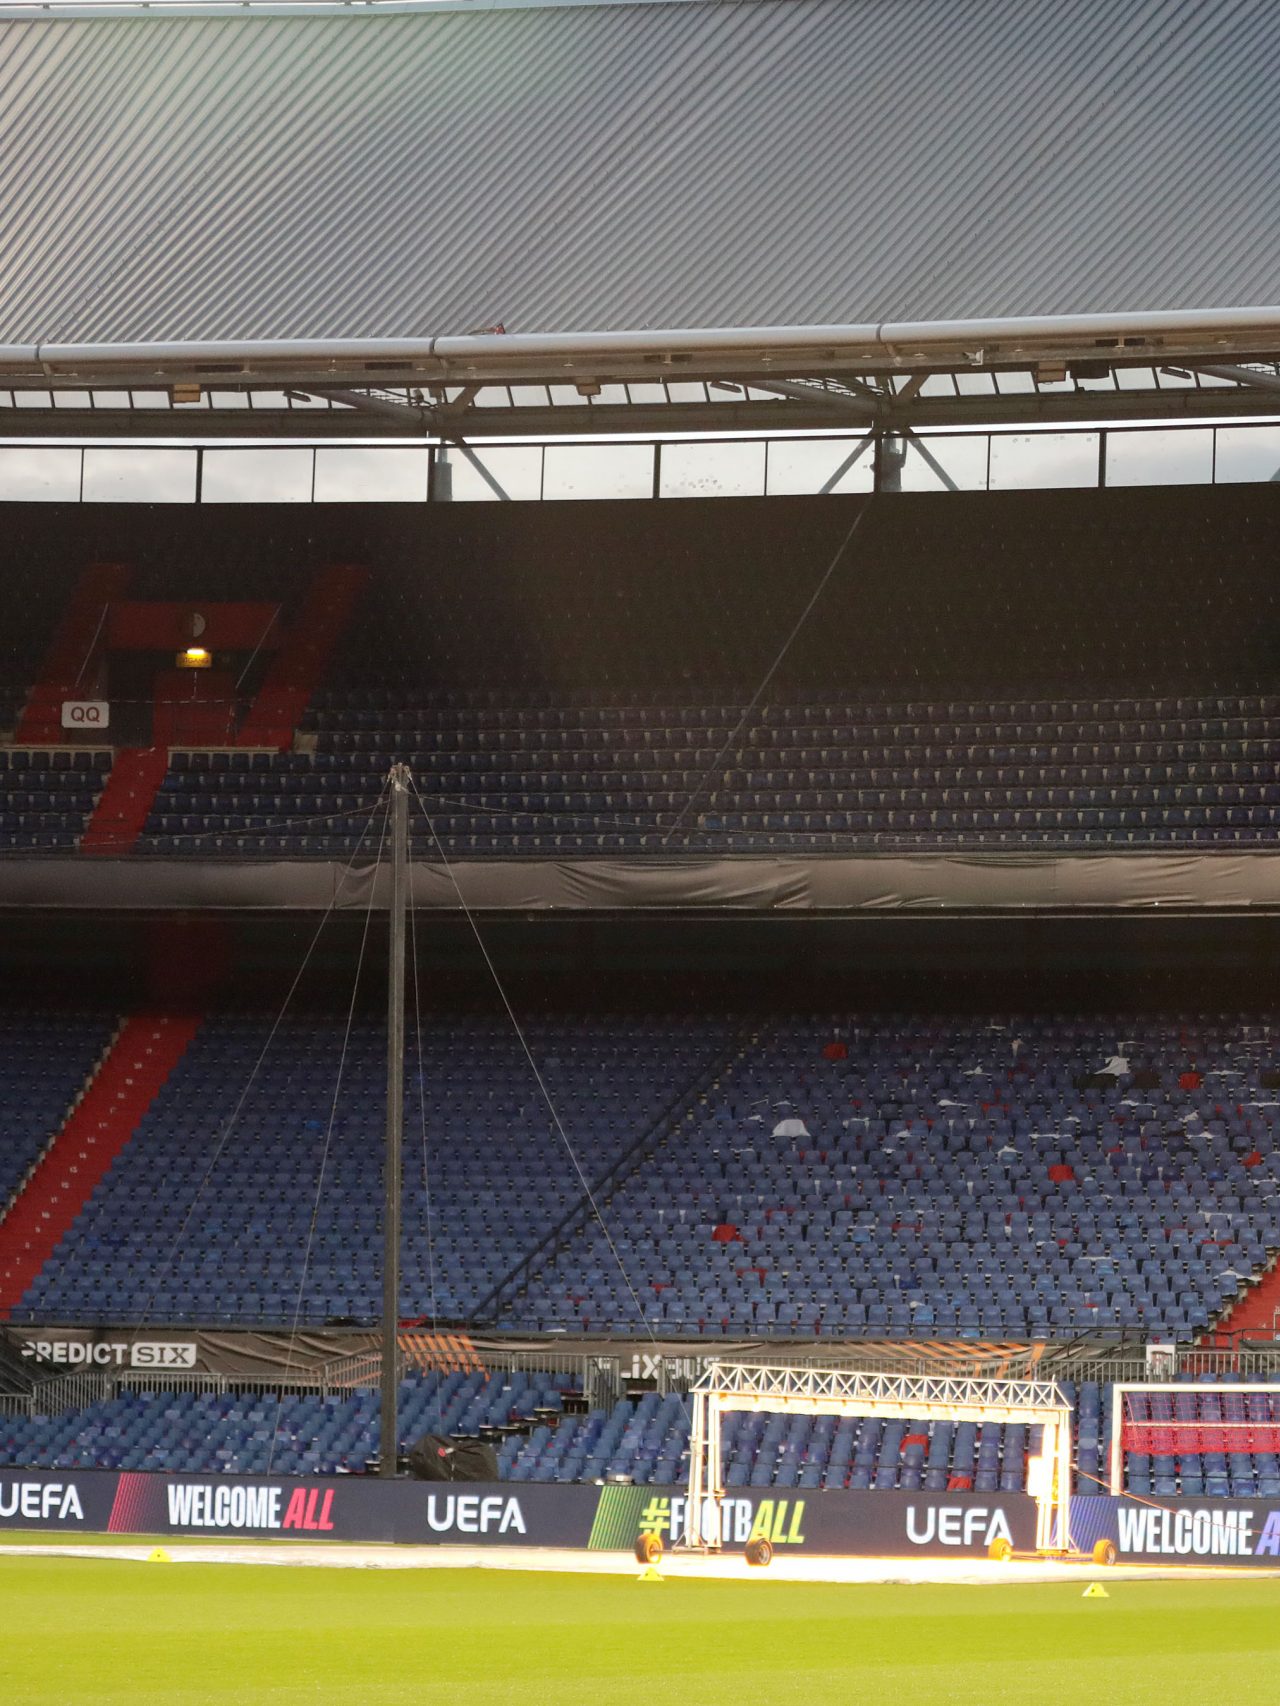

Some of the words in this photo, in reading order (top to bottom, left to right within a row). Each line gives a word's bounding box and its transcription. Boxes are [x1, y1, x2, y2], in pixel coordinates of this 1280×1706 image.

[71, 706, 100, 723] QQ
[136, 1346, 190, 1364] SIX
[0, 1482, 84, 1520] UEFA
[167, 1483, 282, 1529] WELCOME
[283, 1488, 334, 1531] ALL
[427, 1495, 527, 1534] UEFA
[906, 1505, 1014, 1546] UEFA
[1117, 1508, 1253, 1556] WELCOME
